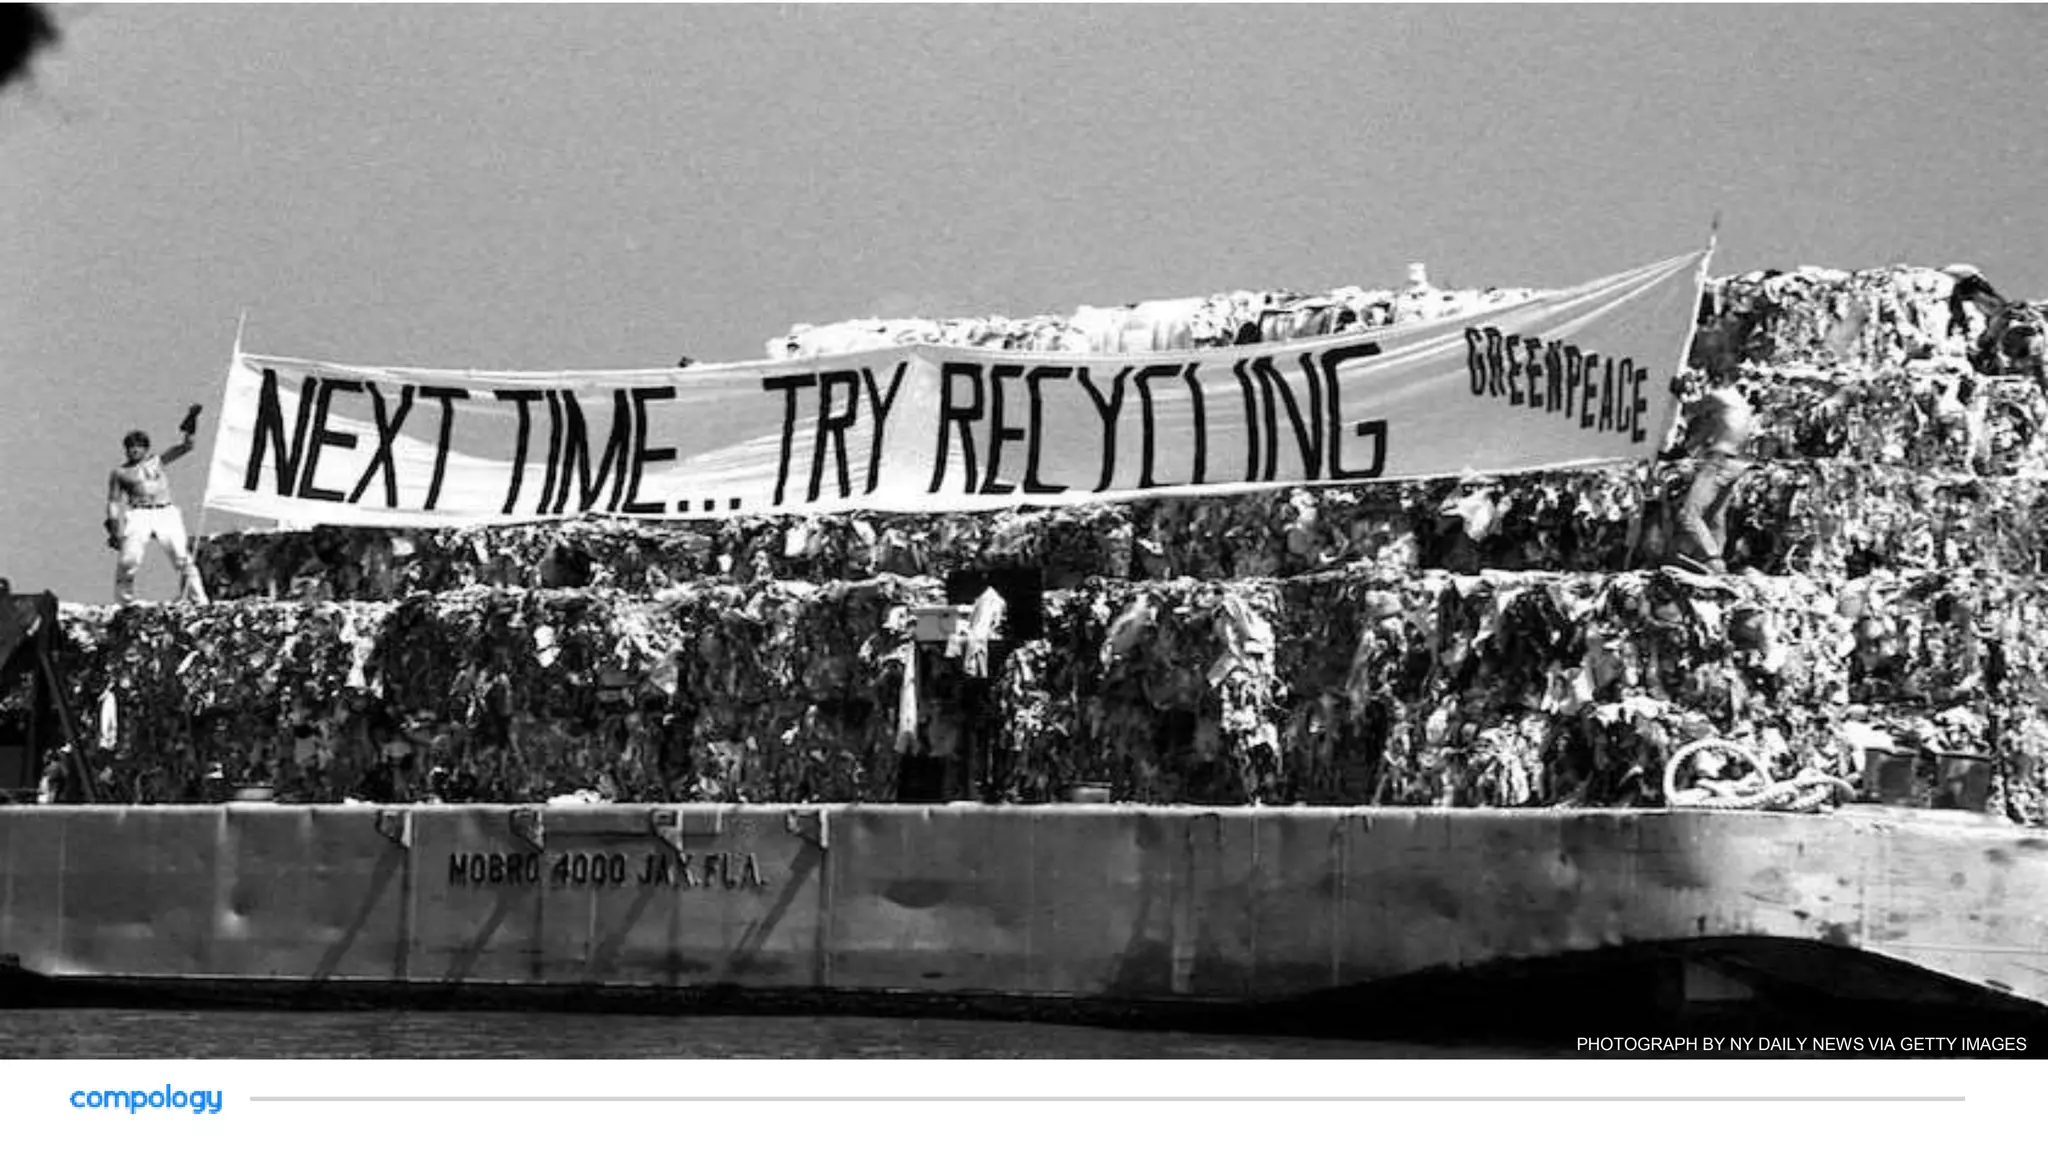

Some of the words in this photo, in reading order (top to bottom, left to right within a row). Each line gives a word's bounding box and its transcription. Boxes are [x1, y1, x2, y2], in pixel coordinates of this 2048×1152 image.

[243, 368, 470, 511] NEXT
[493, 385, 742, 515] TIME...
[762, 361, 908, 506] TRY
[928, 342, 1389, 495] RECYCLING
[1465, 326, 1649, 443] GREENPEACE
[450, 852, 541, 887] MOBRO
[552, 852, 627, 886] 4000
